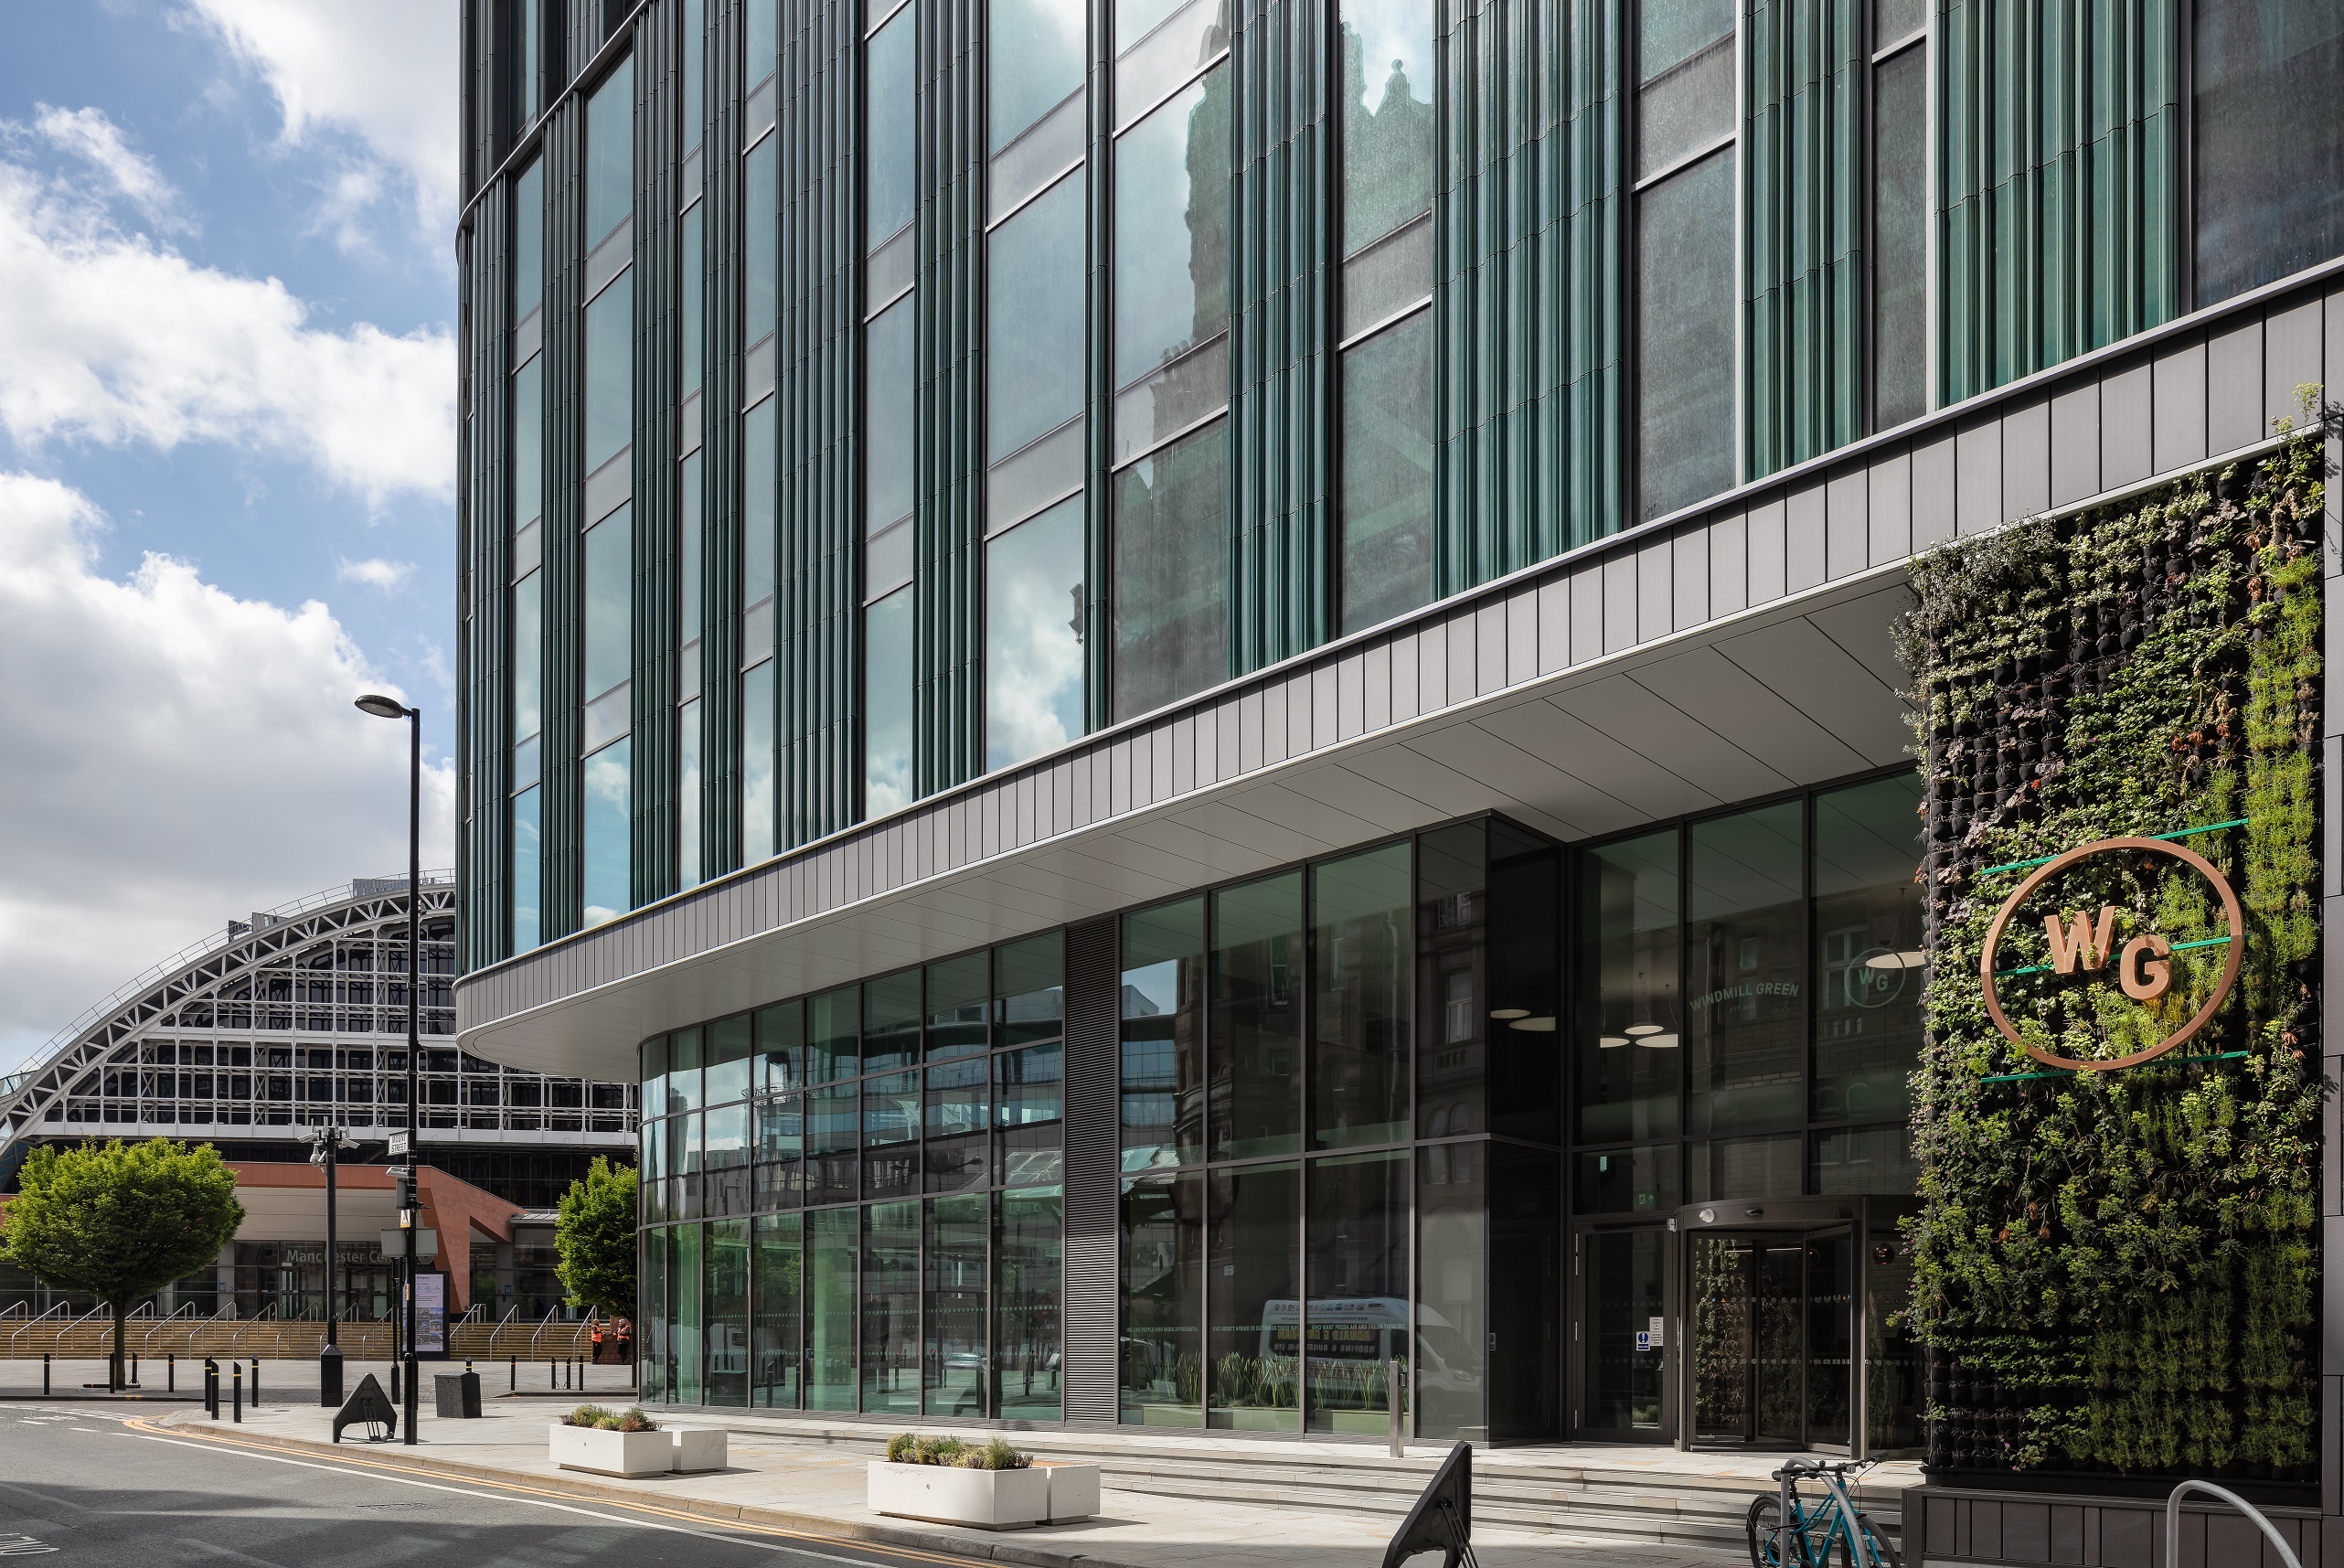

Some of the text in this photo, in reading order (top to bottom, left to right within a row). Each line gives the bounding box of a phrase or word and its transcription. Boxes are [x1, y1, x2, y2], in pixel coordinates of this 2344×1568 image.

[2044, 906, 2172, 1000] WG
[1858, 966, 1889, 991] WG
[1689, 982, 1800, 1011] WINDMILL GREEN
[391, 1143, 407, 1152] STREET
[287, 1249, 365, 1263] Mancester
